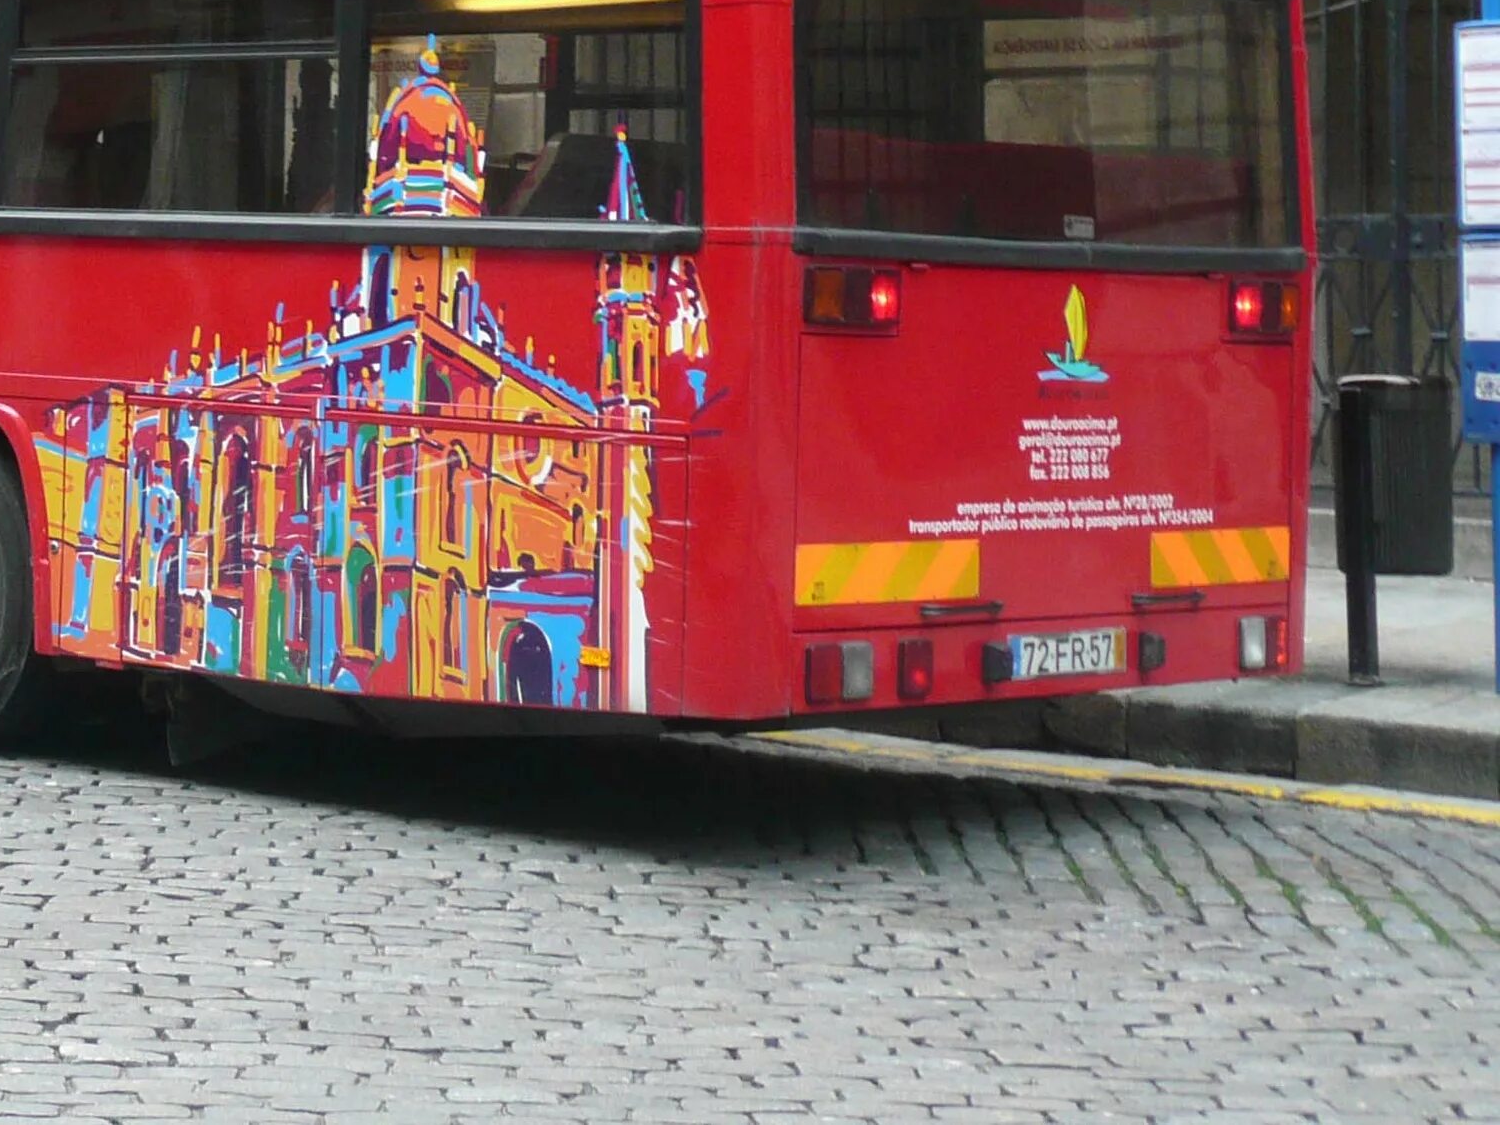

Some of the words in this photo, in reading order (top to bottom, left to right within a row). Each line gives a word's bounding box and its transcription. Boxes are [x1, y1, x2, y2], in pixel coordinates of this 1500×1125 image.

[957, 502, 1001, 518] empresa
[1003, 497, 1016, 514] de
[908, 516, 980, 537] transportador
